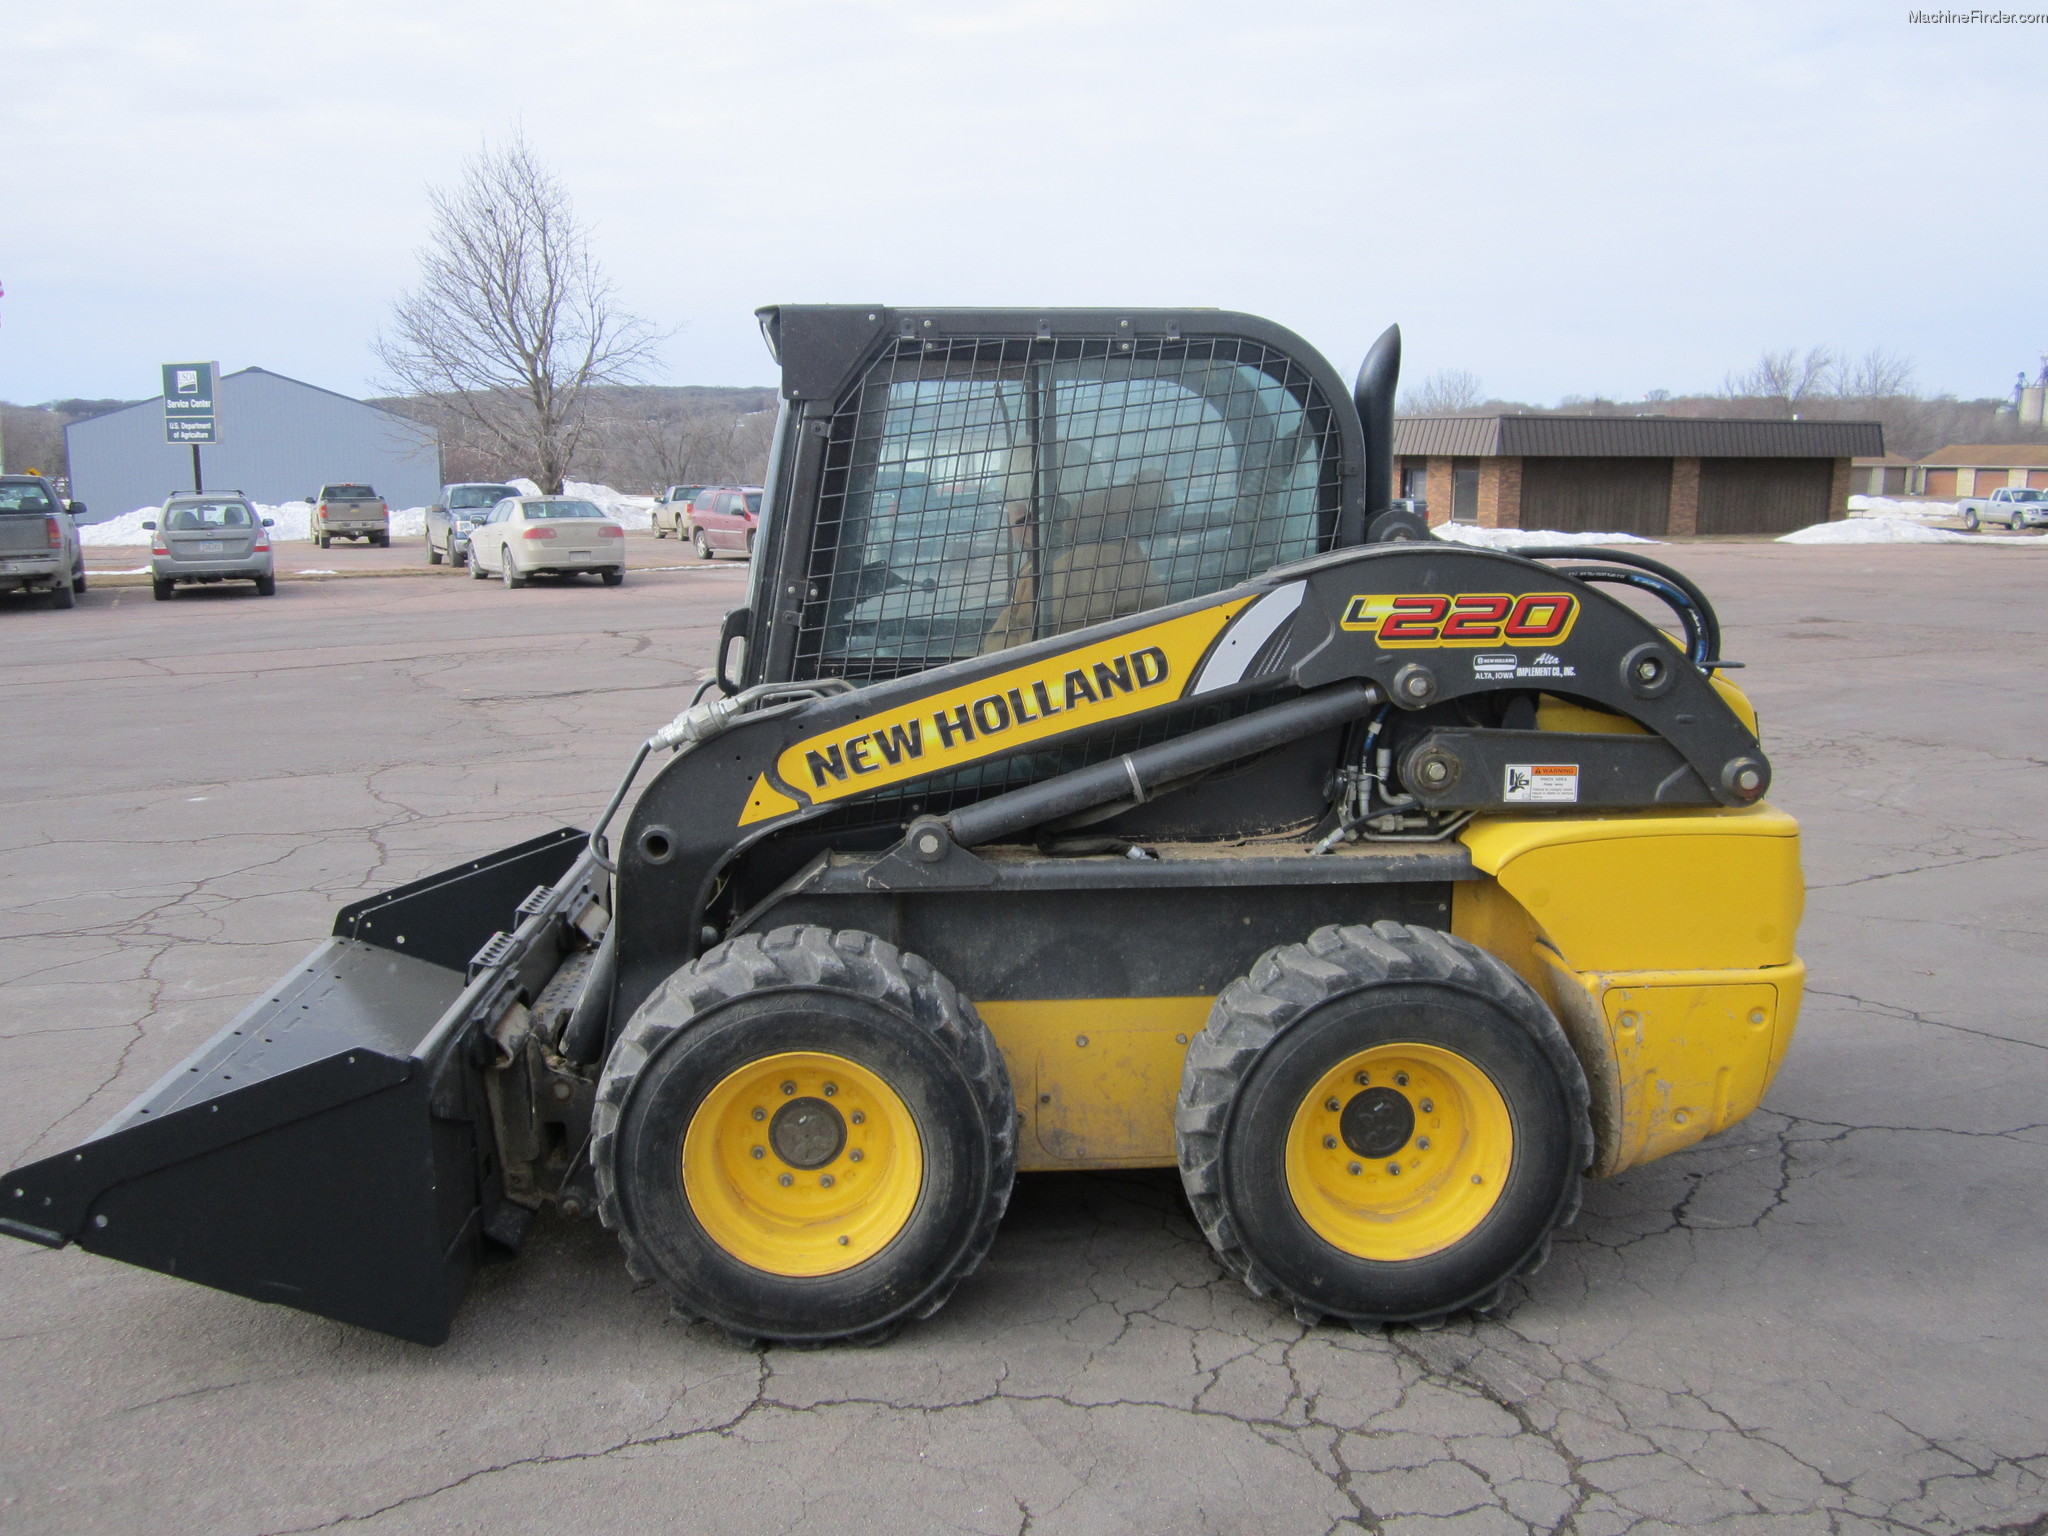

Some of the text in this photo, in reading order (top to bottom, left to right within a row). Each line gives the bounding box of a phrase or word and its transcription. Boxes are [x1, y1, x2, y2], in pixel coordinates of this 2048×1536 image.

[166, 399, 211, 408] Service Center
[169, 422, 212, 431] U.S. Department
[173, 431, 209, 440] of Agriculture
[1533, 653, 1560, 665] Alta
[1475, 672, 1495, 680] ALTA,
[1516, 667, 1551, 677] IMPLEMENT
[1564, 666, 1576, 676] INC.
[805, 645, 1171, 789] NEW HOLLAND
